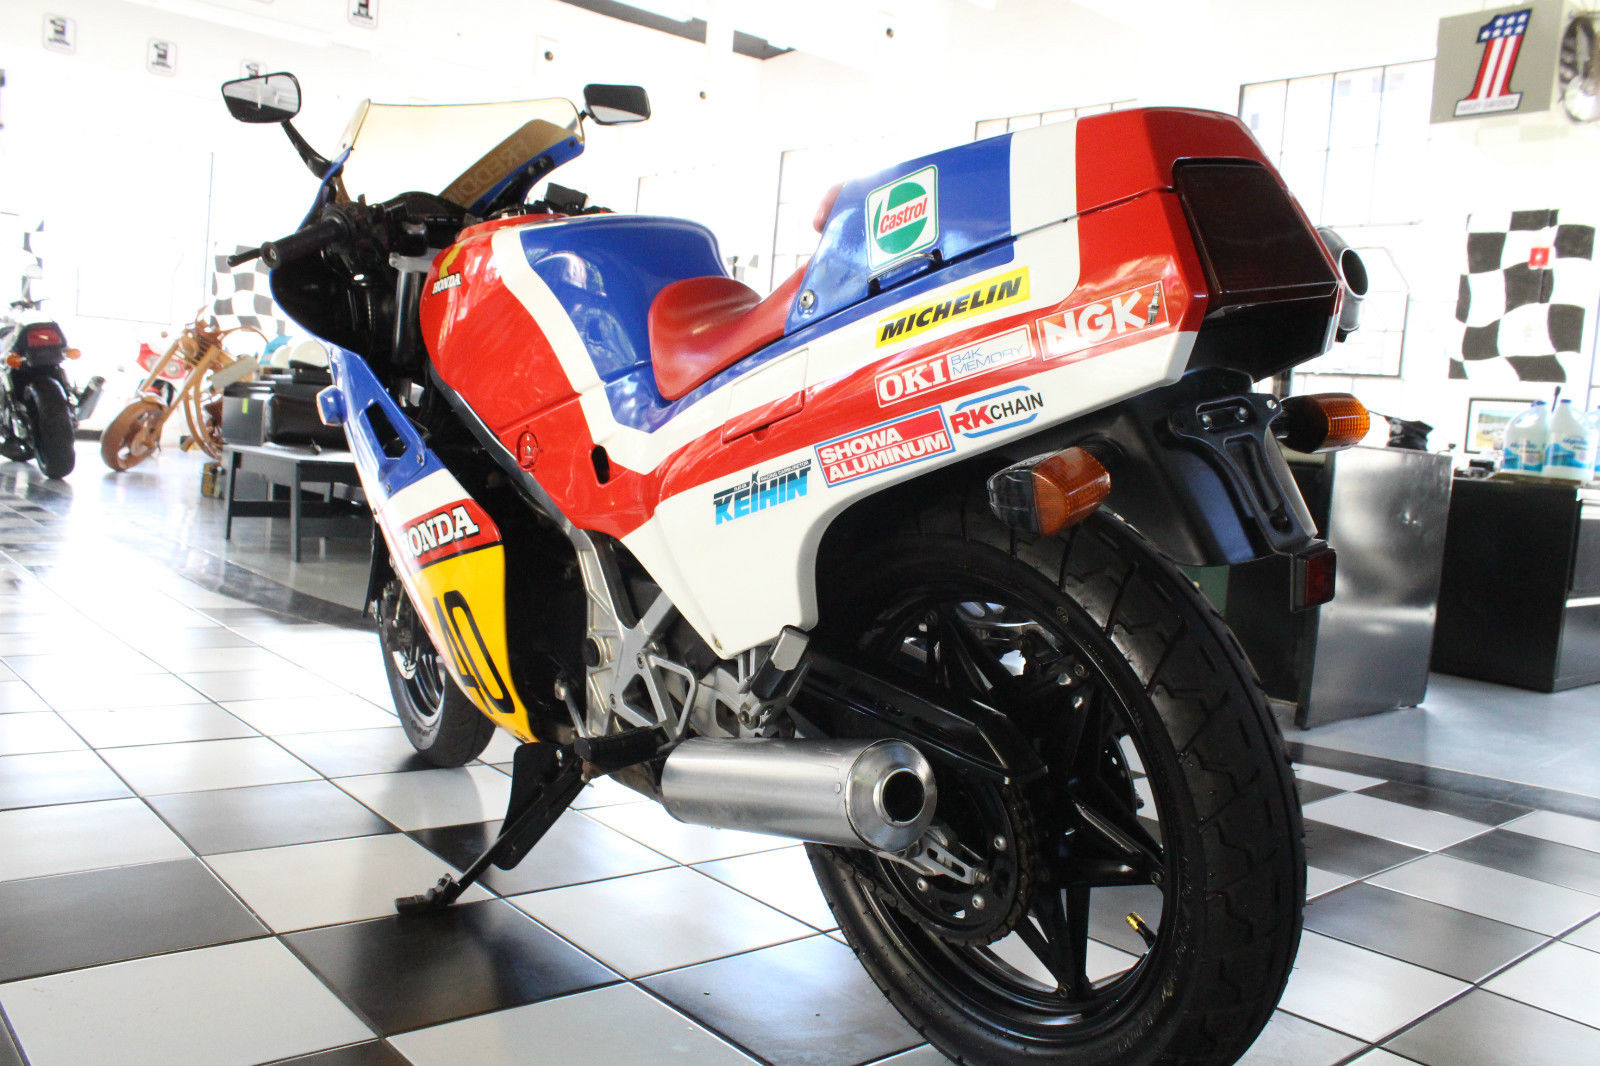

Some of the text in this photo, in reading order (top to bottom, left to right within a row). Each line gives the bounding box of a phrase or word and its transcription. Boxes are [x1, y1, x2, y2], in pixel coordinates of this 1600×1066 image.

[880, 197, 928, 234] Castrol
[432, 272, 461, 295] HONDA
[880, 276, 1022, 342] MICHELIN
[1043, 291, 1146, 354] NGK
[879, 358, 947, 402] OKI
[952, 344, 1023, 376] MEMORY
[820, 427, 904, 464] SHOWA
[829, 431, 949, 482] ALUMINUM
[713, 466, 811, 525] KEIHIN
[432, 589, 516, 715] 40
